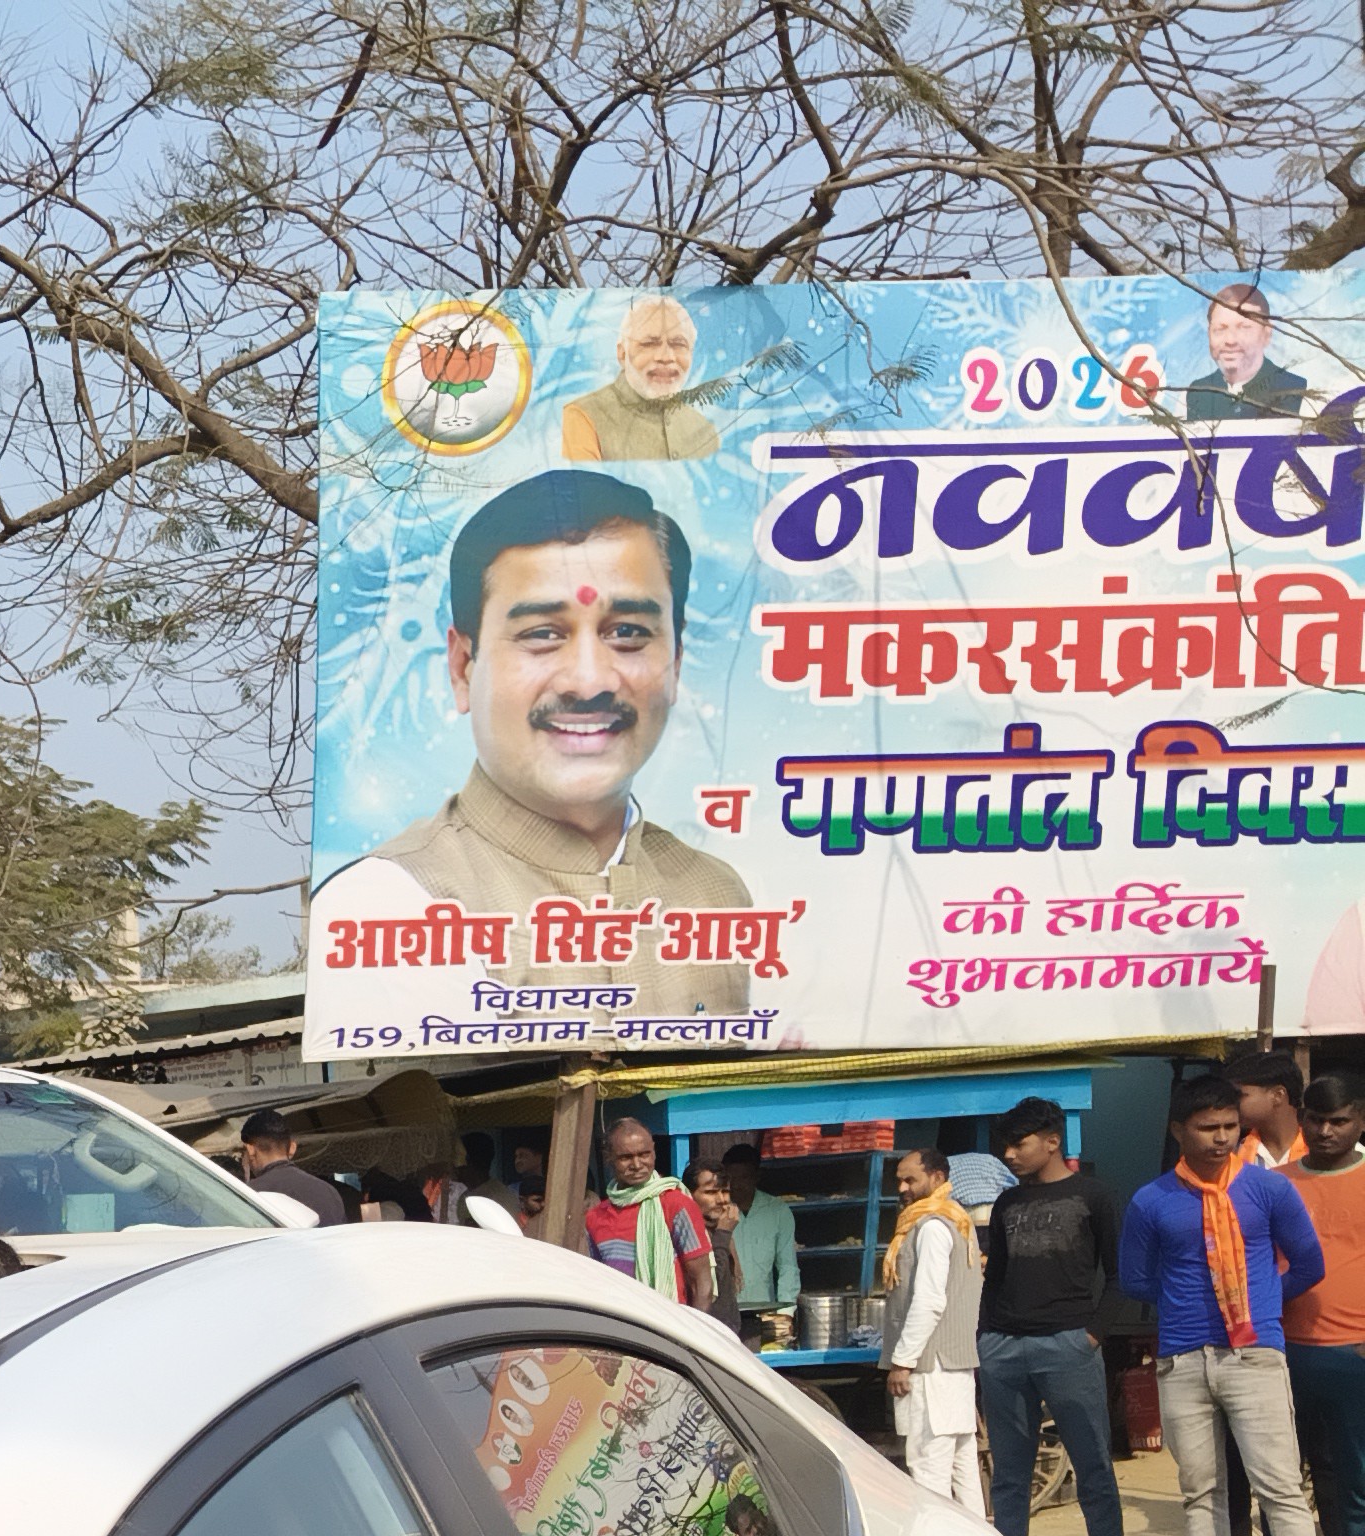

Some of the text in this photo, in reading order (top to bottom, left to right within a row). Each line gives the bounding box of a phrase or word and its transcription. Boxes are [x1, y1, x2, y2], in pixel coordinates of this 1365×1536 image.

[967, 355, 1160, 413] 2026
[700, 789, 752, 834] व
[943, 882, 1245, 936] की हार्दिक
[326, 904, 513, 969] आशीष
[471, 981, 636, 1012] विधायक
